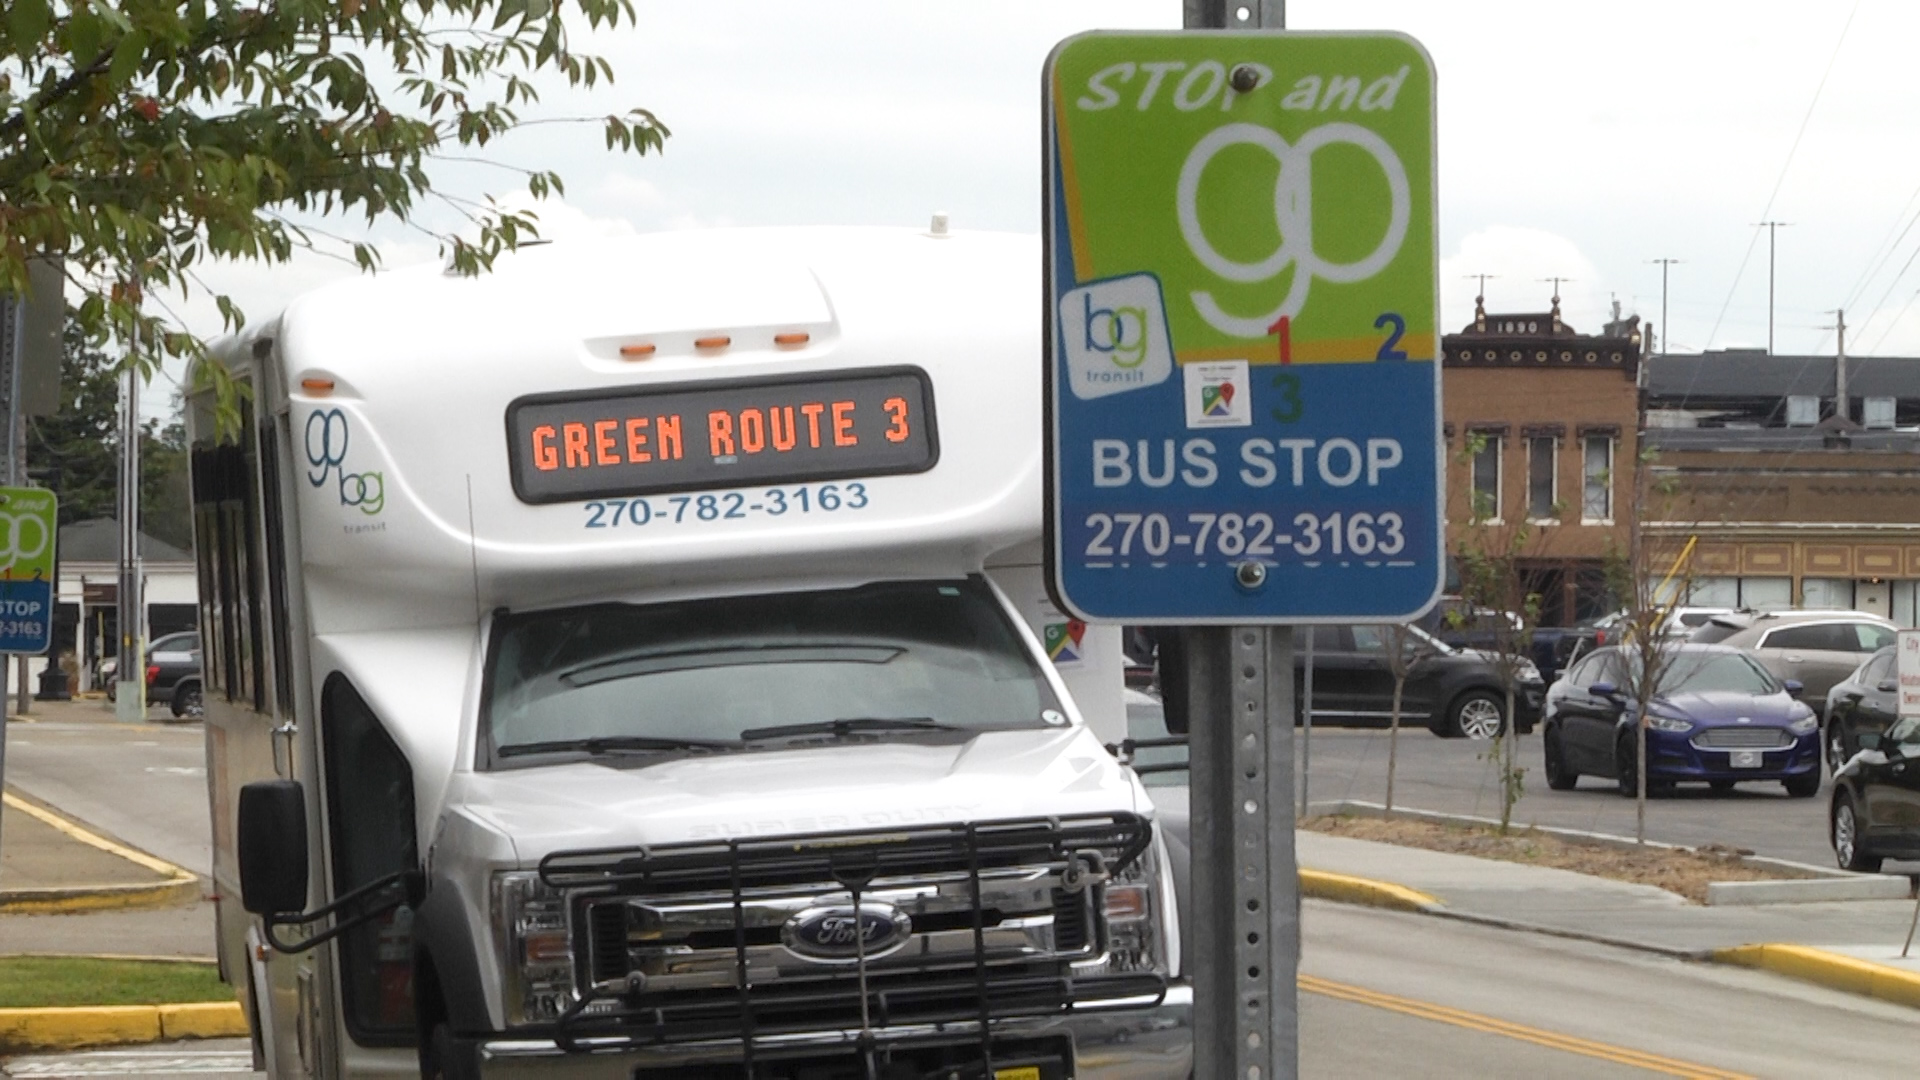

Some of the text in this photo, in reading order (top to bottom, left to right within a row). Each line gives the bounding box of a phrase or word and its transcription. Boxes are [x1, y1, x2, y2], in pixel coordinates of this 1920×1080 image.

[1076, 59, 1411, 112] STOP and
[1176, 122, 1412, 338] go
[1084, 292, 1147, 369] bg
[1267, 312, 1408, 364] 1 2
[1086, 369, 1145, 382] transit
[1271, 373, 1303, 424] 3
[305, 408, 348, 488] go
[531, 397, 910, 472] GREEN ROUTE 3
[1093, 437, 1404, 487] BUS STOP
[338, 465, 385, 516] bg
[584, 482, 869, 528] 270-782-3163
[343, 521, 387, 534] transit
[1085, 512, 1405, 555] 270-782-3163
[818, 916, 877, 944] Ford
